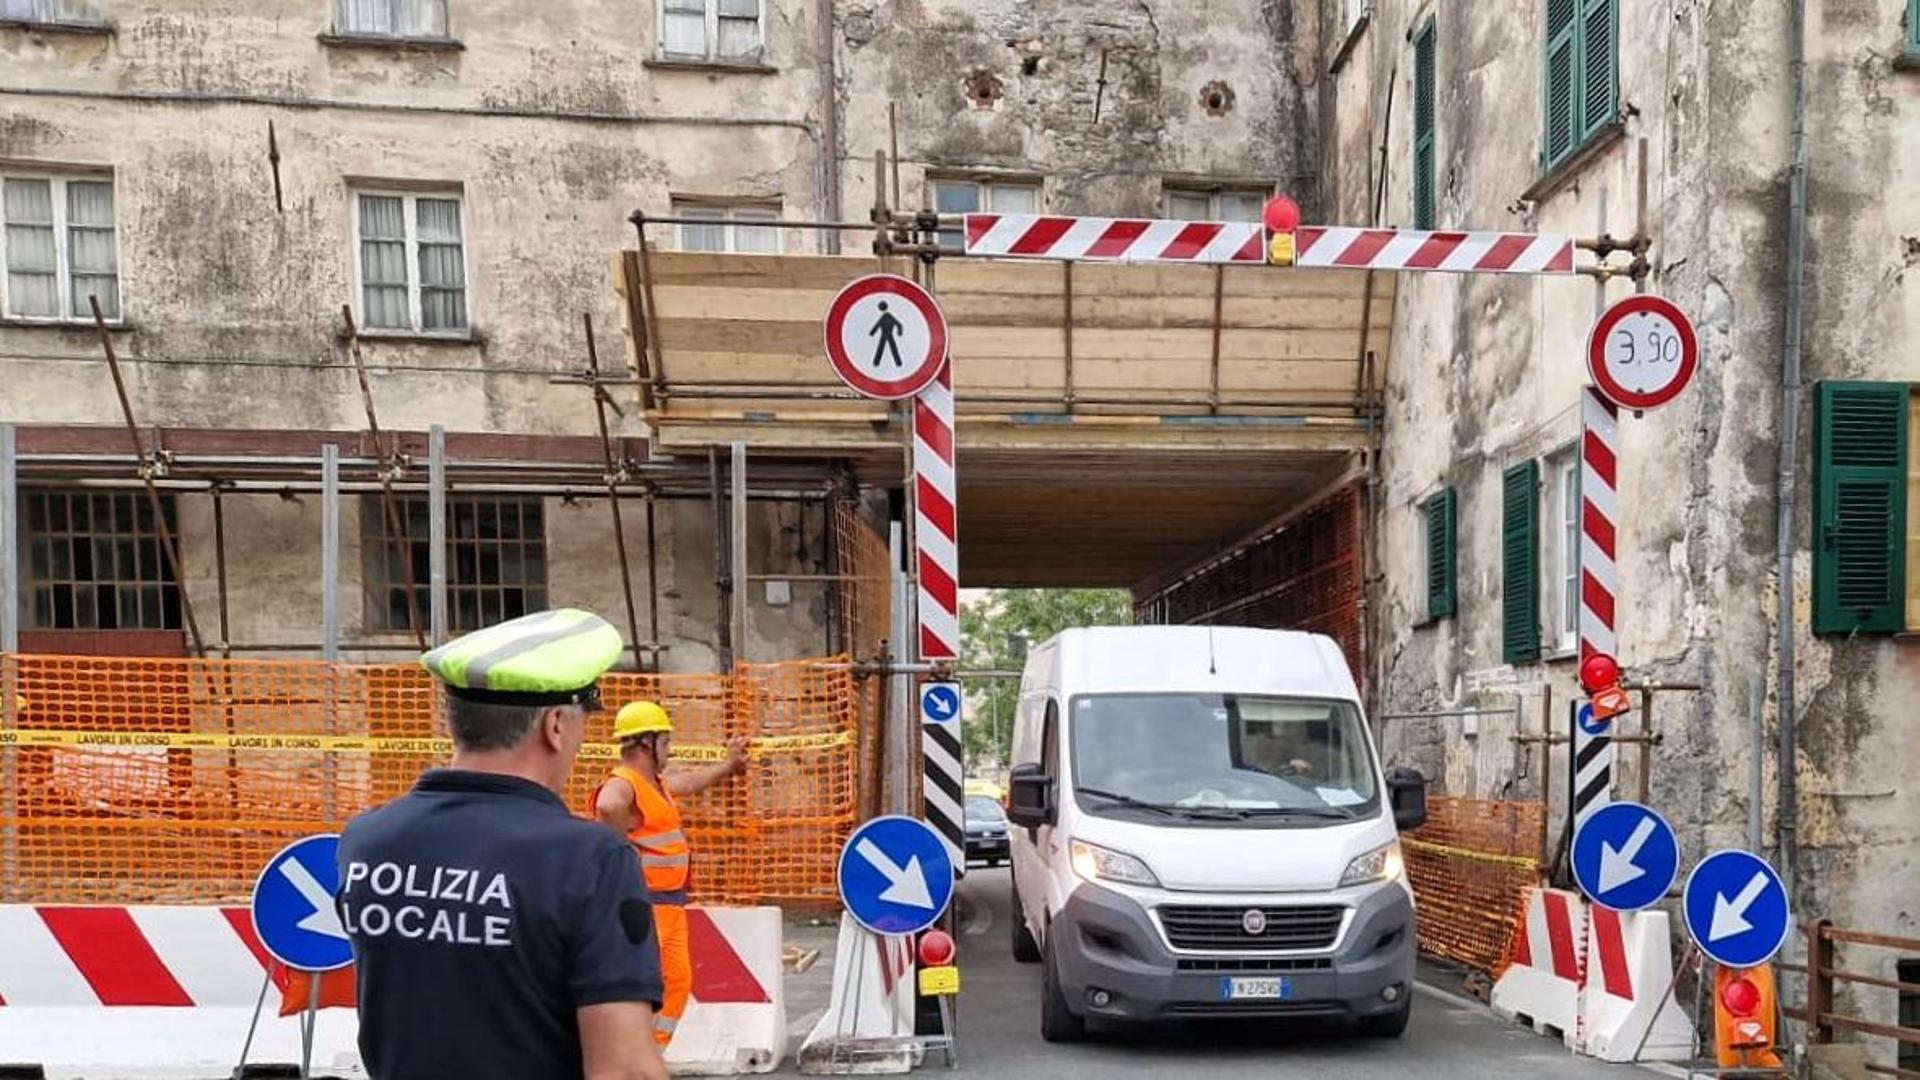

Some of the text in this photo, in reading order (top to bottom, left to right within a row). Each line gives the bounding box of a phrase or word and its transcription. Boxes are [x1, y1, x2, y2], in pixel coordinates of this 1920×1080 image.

[77, 734, 170, 745] LAVORI IN CORSO
[229, 738, 320, 749] LAVORI IN CORSO
[378, 741, 452, 752] LAVORI IN COR
[578, 746, 612, 756] CORSO
[668, 749, 702, 759] AVORI
[706, 750, 717, 759] IN
[345, 862, 511, 908] POLIZIA
[344, 902, 511, 945] LOCALE
